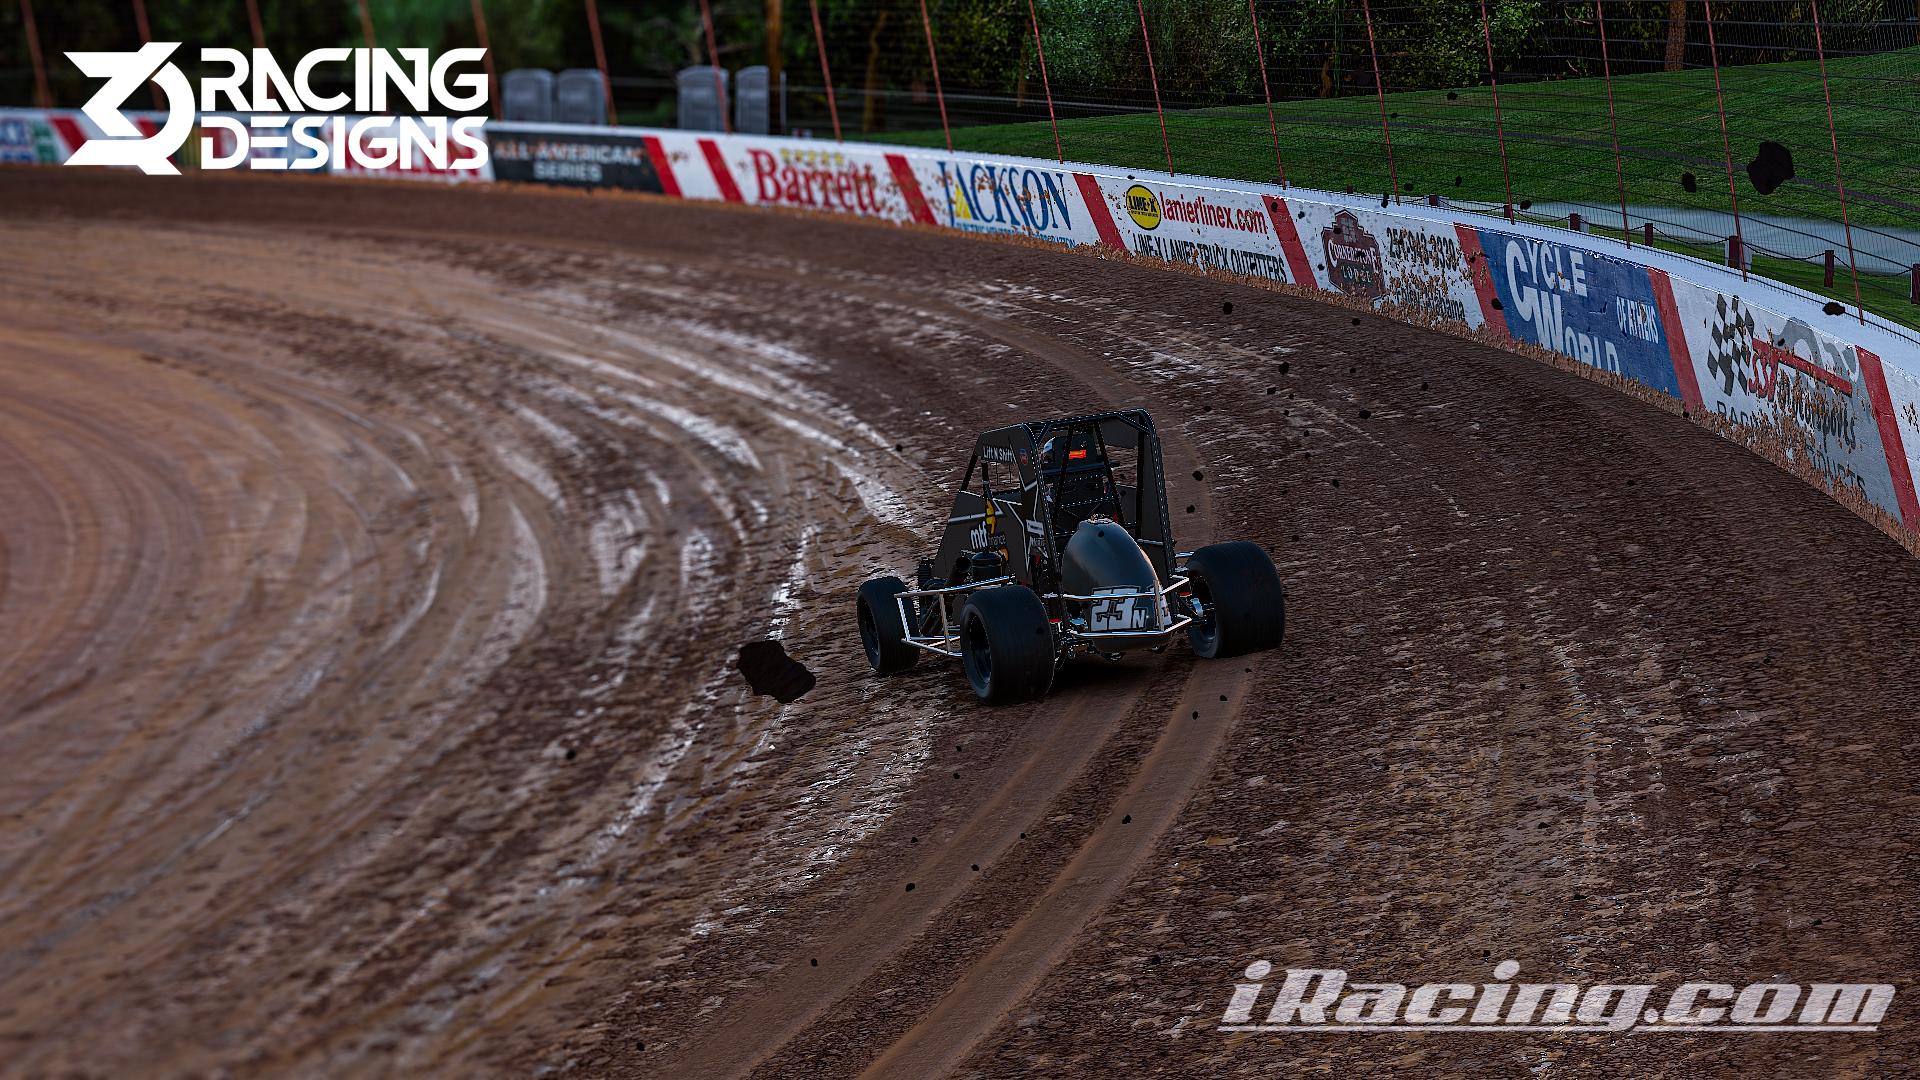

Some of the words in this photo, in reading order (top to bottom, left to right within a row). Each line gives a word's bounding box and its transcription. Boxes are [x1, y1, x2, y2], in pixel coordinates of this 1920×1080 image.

[746, 148, 882, 213] Barrett
[937, 160, 1074, 231] JACKSON
[1159, 191, 1268, 235] lanierlinex.com
[1197, 242, 1230, 271] TRUCK
[1230, 248, 1288, 284] OUTFITTERS
[1505, 239, 1588, 322] CYCLE
[1522, 285, 1621, 376] WORLD
[1616, 295, 1628, 334] OF
[1627, 298, 1659, 344] ATHENS
